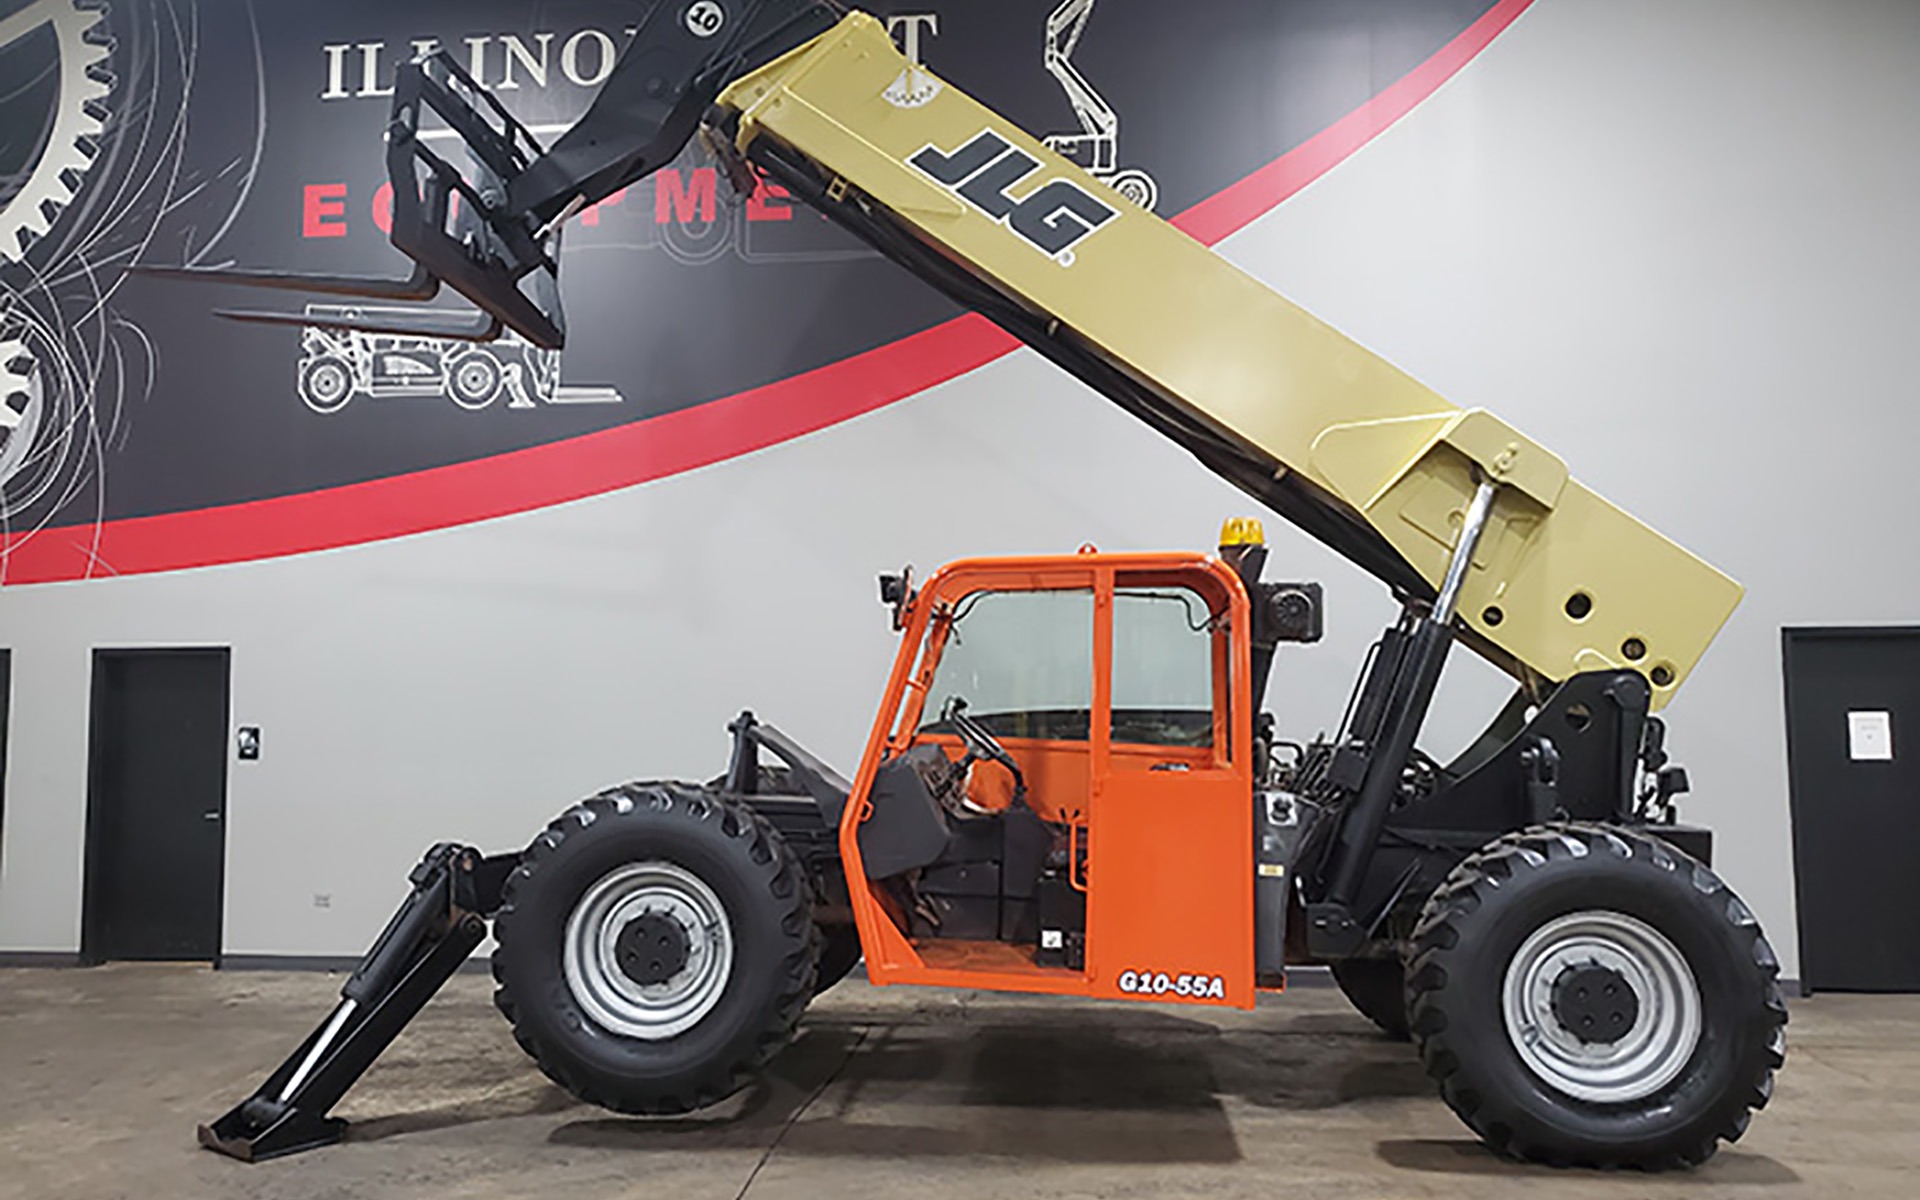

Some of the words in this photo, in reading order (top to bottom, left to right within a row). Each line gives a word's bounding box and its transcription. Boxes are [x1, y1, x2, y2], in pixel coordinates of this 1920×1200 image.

[690, 7, 719, 31] 10
[904, 127, 1122, 259] JLG
[1119, 971, 1224, 998] G10-55A
